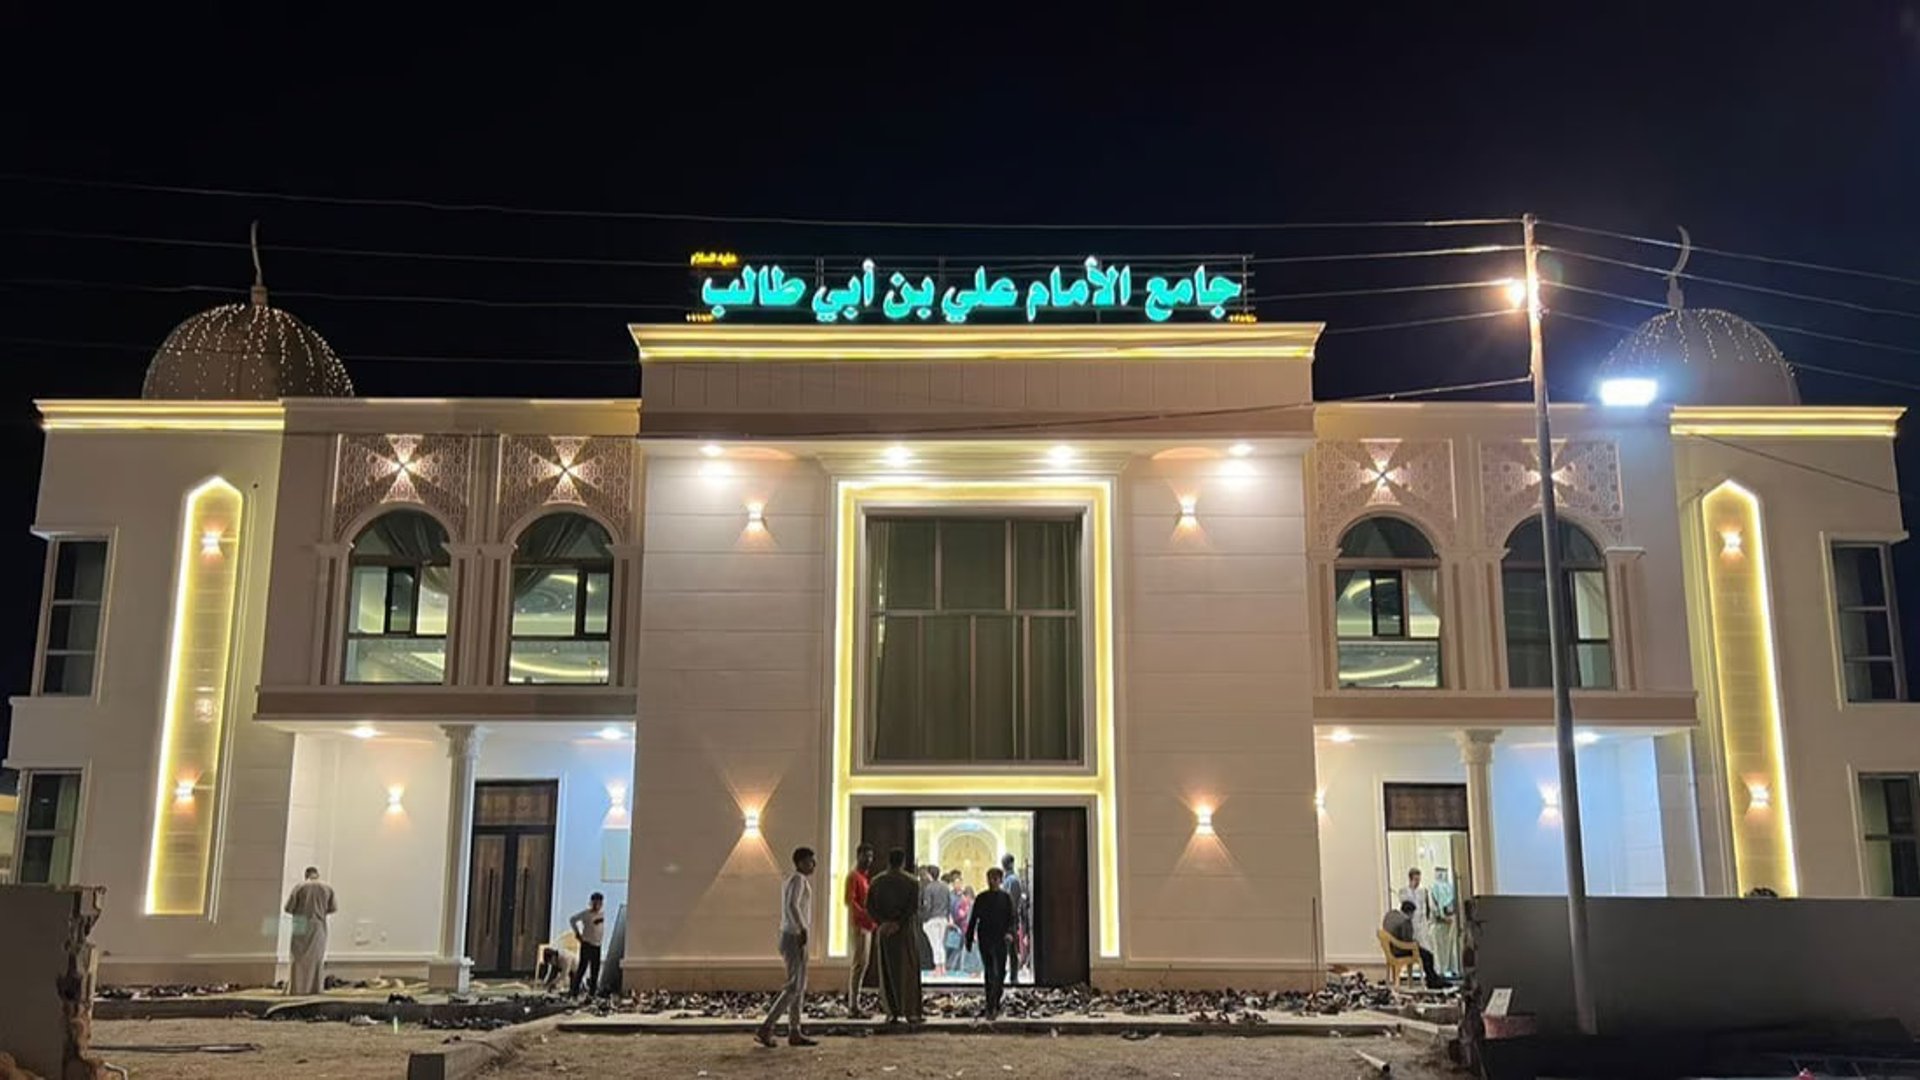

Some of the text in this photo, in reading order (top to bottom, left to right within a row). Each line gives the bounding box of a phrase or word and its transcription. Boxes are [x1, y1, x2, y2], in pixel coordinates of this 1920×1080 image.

[702, 265, 806, 319] طالب
[811, 258, 875, 323] أبي
[882, 271, 936, 320] بن
[940, 265, 1019, 323] علي
[1145, 265, 1242, 321] جامع
